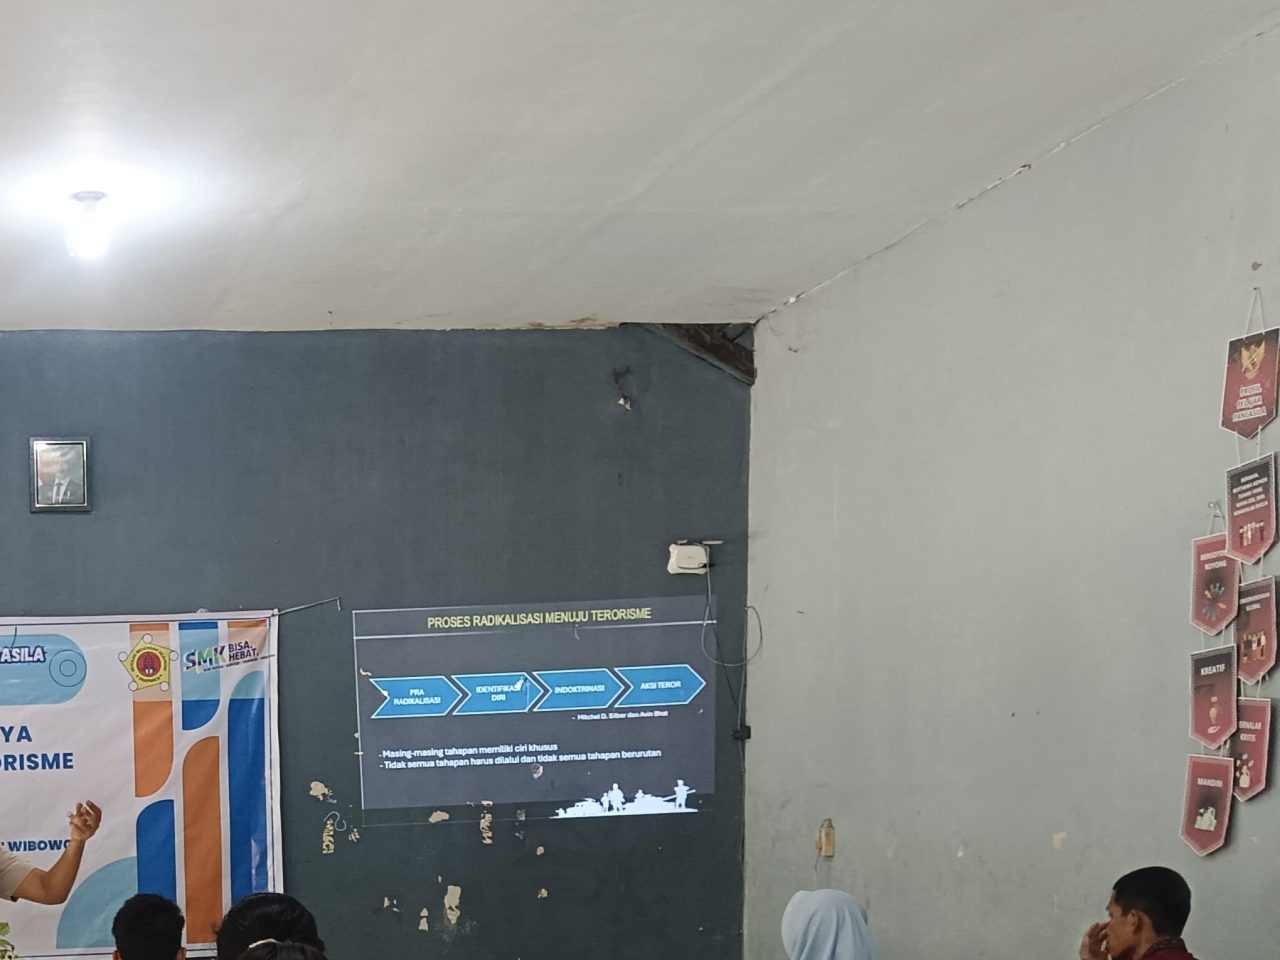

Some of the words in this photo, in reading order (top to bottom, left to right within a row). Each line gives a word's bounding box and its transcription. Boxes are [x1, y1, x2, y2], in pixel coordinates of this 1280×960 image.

[428, 615, 470, 629] PROSES
[473, 613, 544, 627] RADIKALISASI
[545, 610, 589, 623] MENUJU
[591, 608, 652, 621] TERORISME
[229, 640, 253, 653] BISA.
[184, 645, 226, 673] SMK
[229, 647, 259, 662] HEBAT.
[1201, 664, 1226, 675] KREATIF
[554, 685, 605, 694] INDOKTRINASI
[657, 681, 681, 689] TEROR
[393, 697, 441, 705] RADIKALISASI
[444, 747, 478, 757] tahapan
[479, 744, 513, 754] memiliki
[514, 744, 527, 752] ciri
[528, 743, 558, 752] khusus
[407, 760, 435, 768] semua
[436, 758, 470, 768] tahapan
[470, 757, 494, 766] harus
[495, 756, 519, 764] dilalui
[520, 755, 536, 763] dan
[537, 754, 558, 762] tidak
[559, 753, 586, 761] semua
[587, 751, 620, 761] tahapan
[621, 749, 662, 758] berurutan
